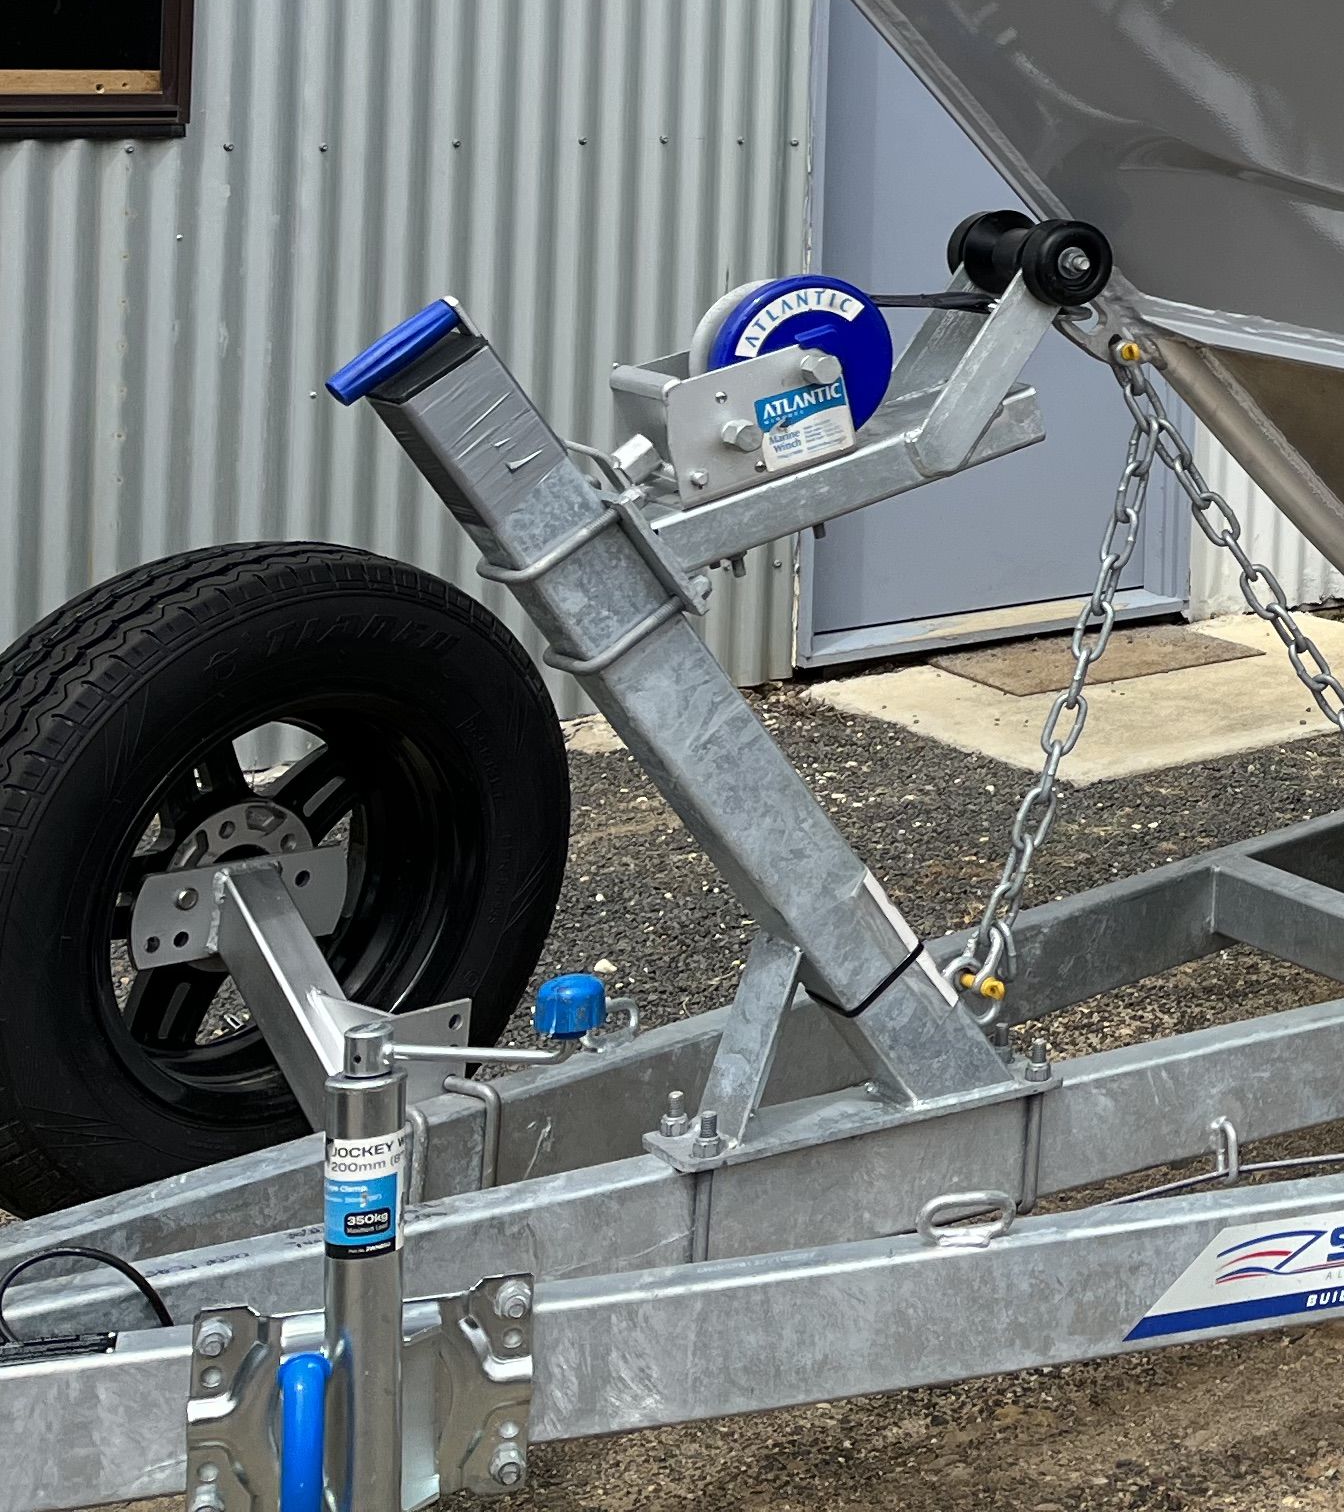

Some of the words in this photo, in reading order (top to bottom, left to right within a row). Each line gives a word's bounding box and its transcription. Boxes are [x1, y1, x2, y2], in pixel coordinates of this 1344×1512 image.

[745, 290, 852, 348] ATLANTIC
[763, 383, 841, 419] ATLANTIC
[332, 1141, 393, 1158] JOCKEY
[331, 1160, 386, 1172] 200mm
[347, 1213, 388, 1226] 350kg
